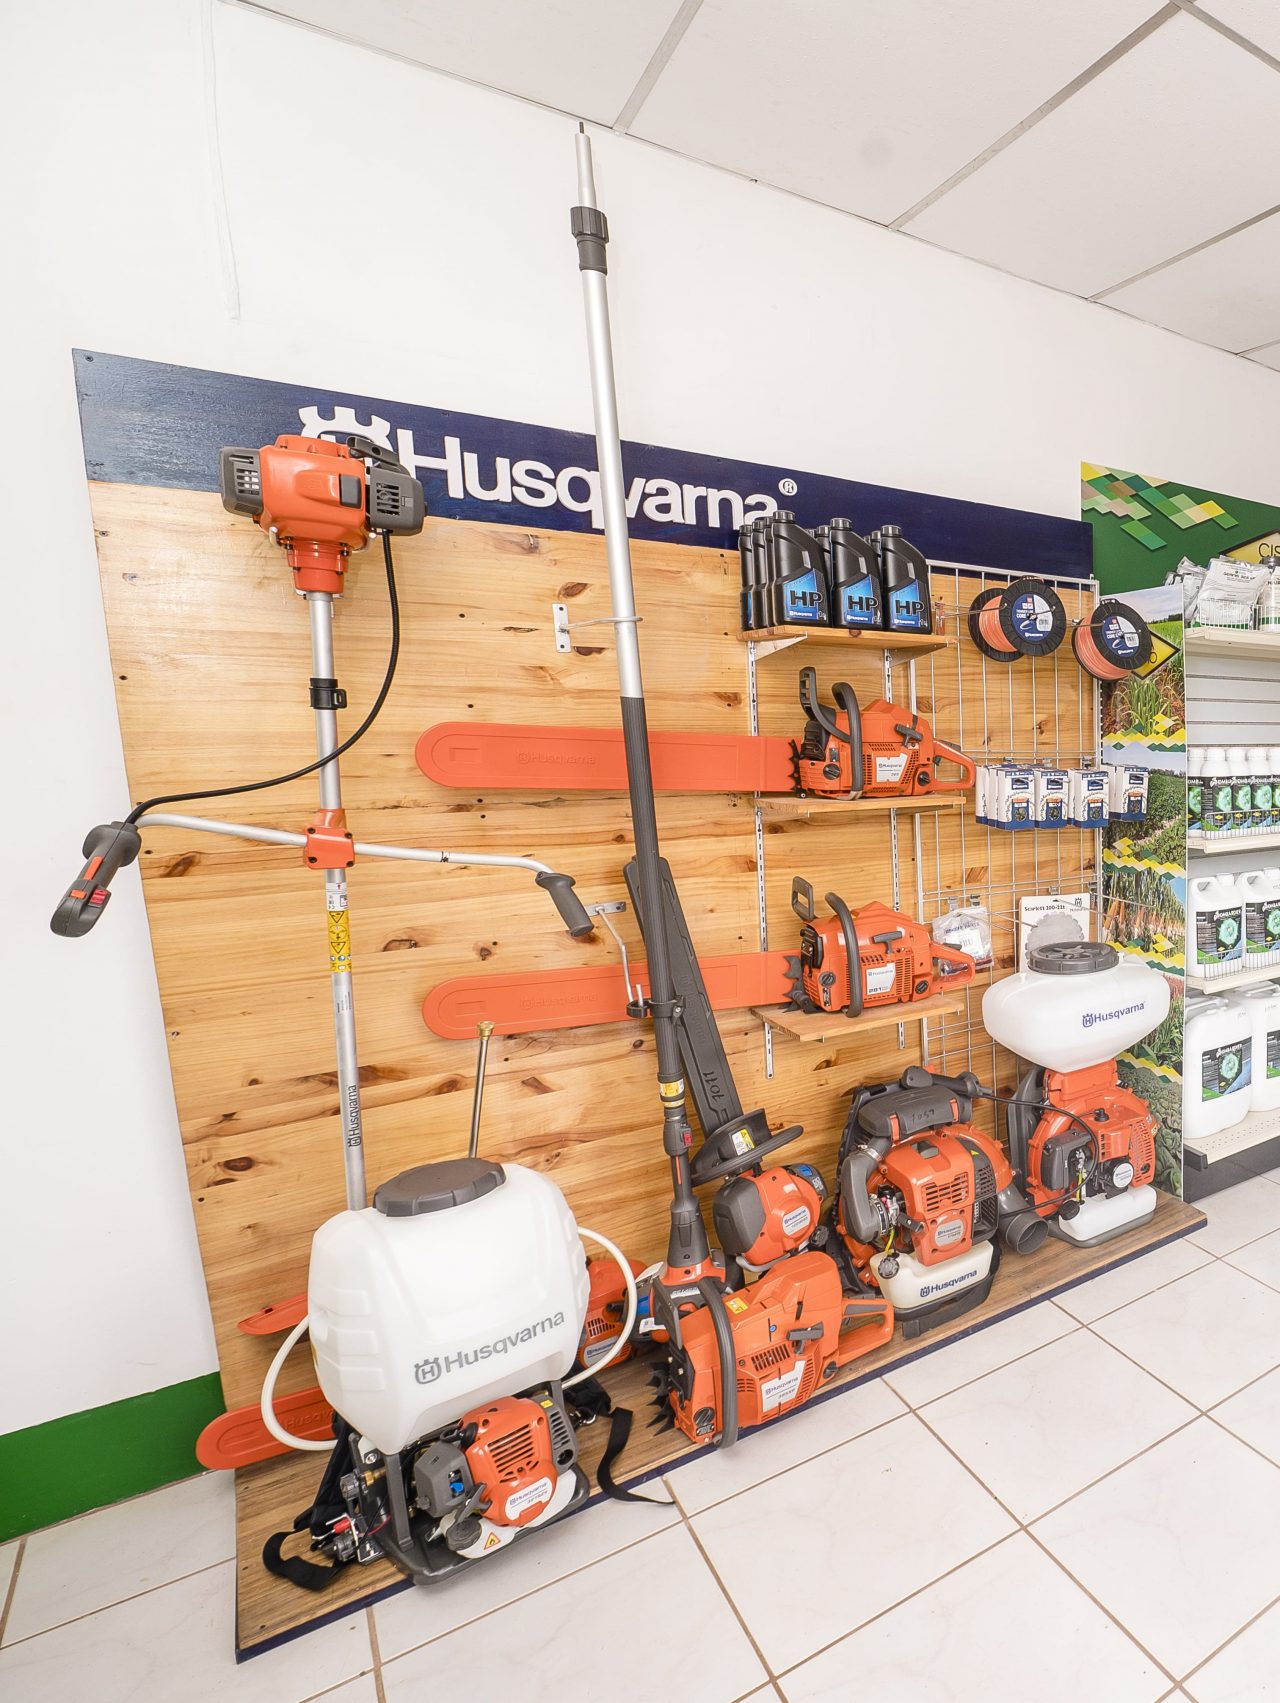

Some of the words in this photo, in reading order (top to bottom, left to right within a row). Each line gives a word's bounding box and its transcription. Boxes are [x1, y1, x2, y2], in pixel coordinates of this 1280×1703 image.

[790, 590, 823, 607] HP
[848, 595, 878, 612] HP
[895, 599, 925, 615] HP
[1093, 1001, 1146, 1023] Husqvarna
[347, 1084, 360, 1137] Husqvarna
[931, 1269, 978, 1293] Husqvarna
[444, 1311, 565, 1374] Husqvarna
